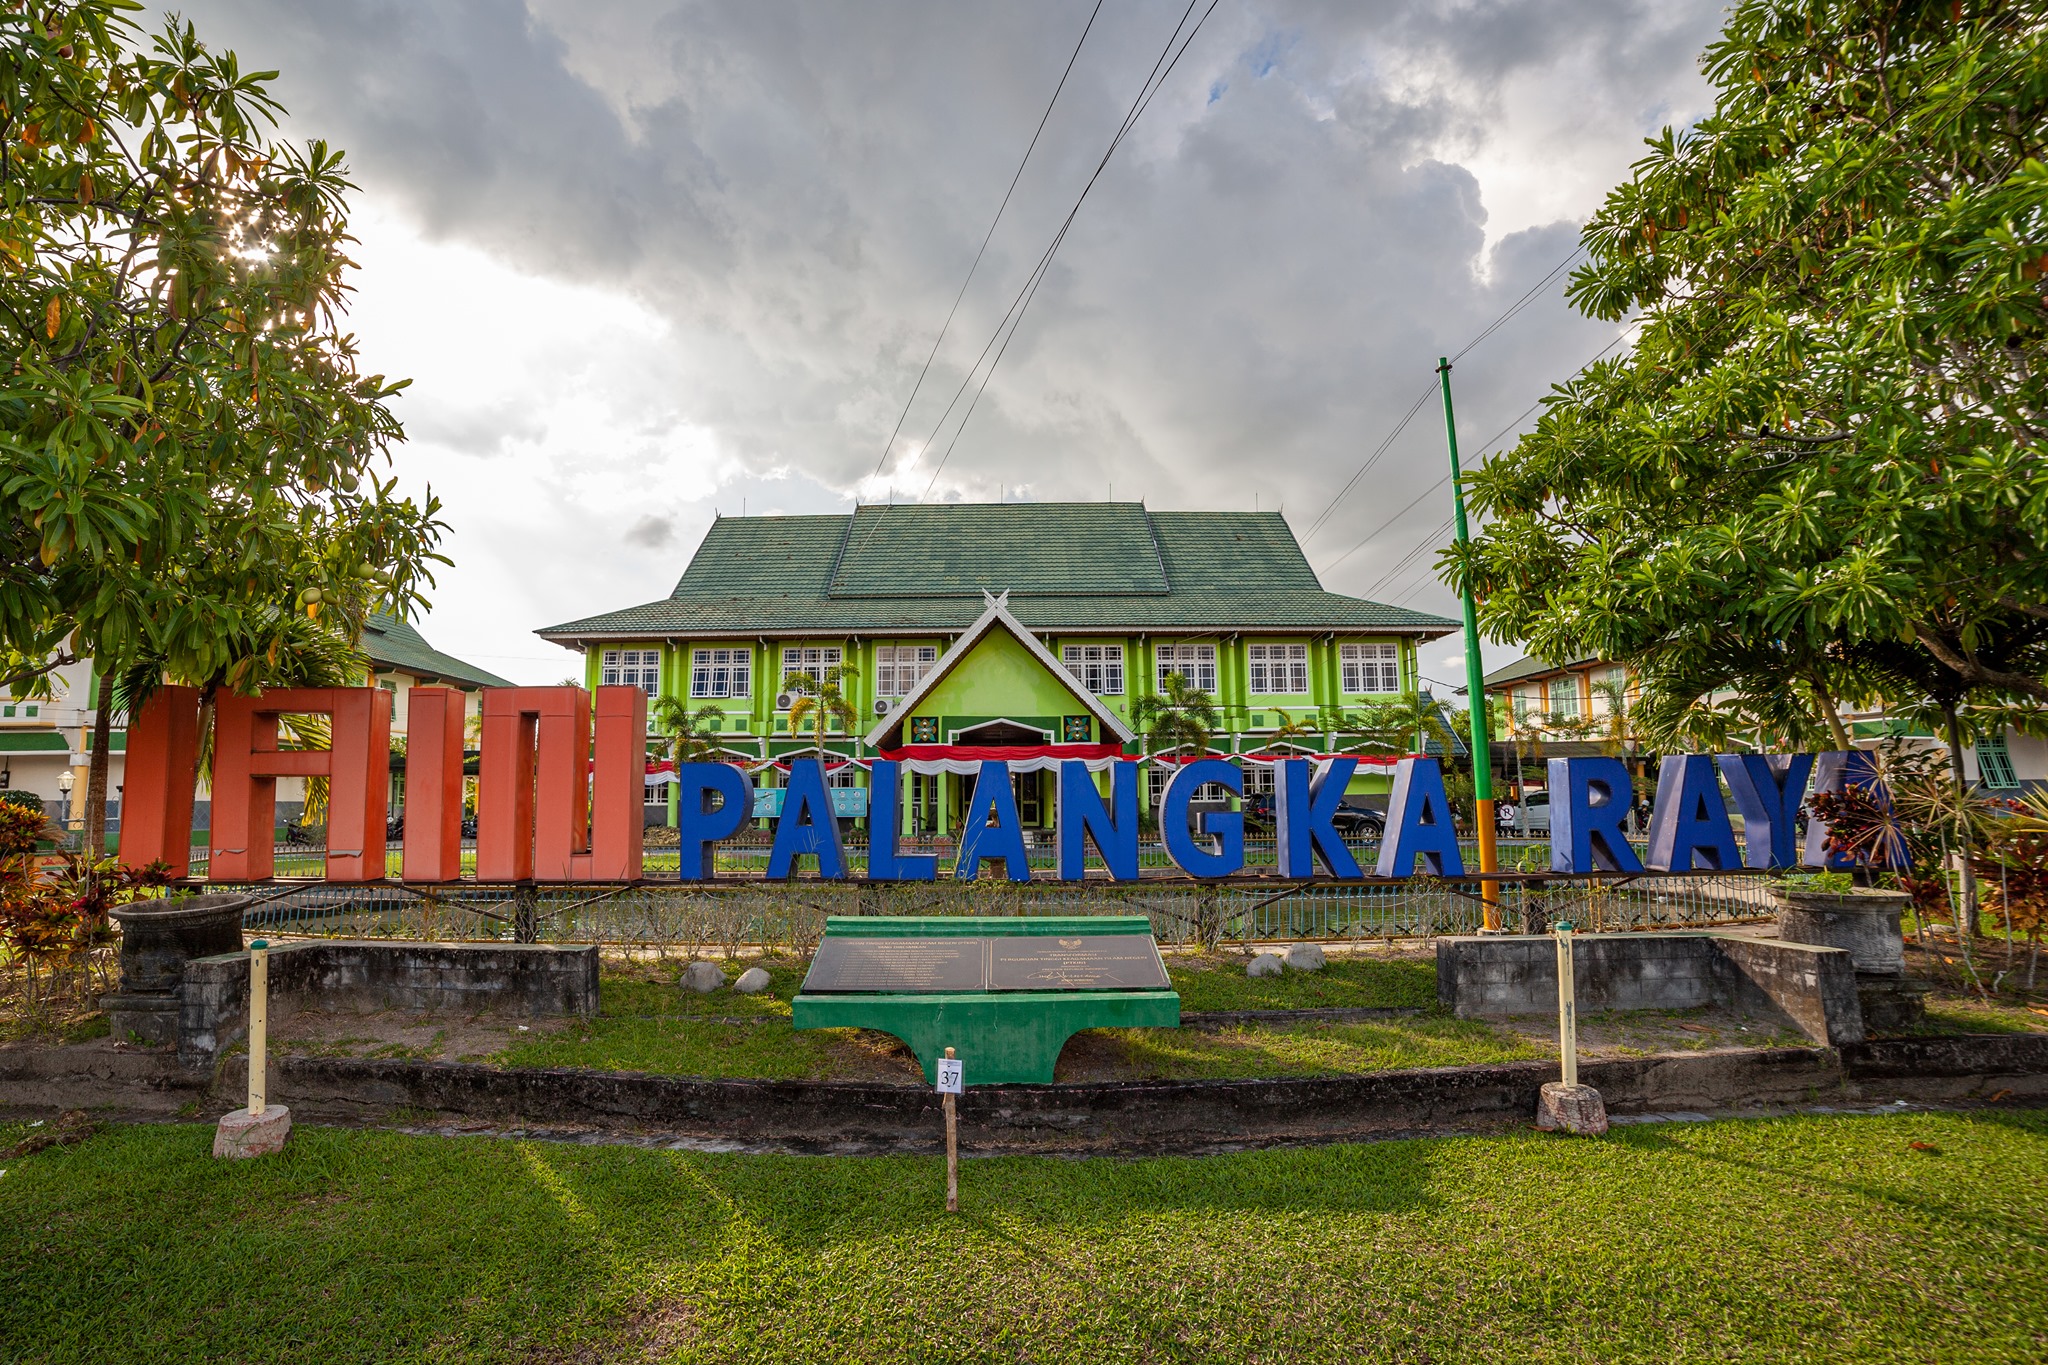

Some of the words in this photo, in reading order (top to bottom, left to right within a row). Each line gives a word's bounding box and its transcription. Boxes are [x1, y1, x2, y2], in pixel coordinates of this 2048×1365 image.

[119, 685, 647, 882] IAIN
[679, 757, 1465, 882] PALANGKA
[941, 1070, 959, 1086] 37
